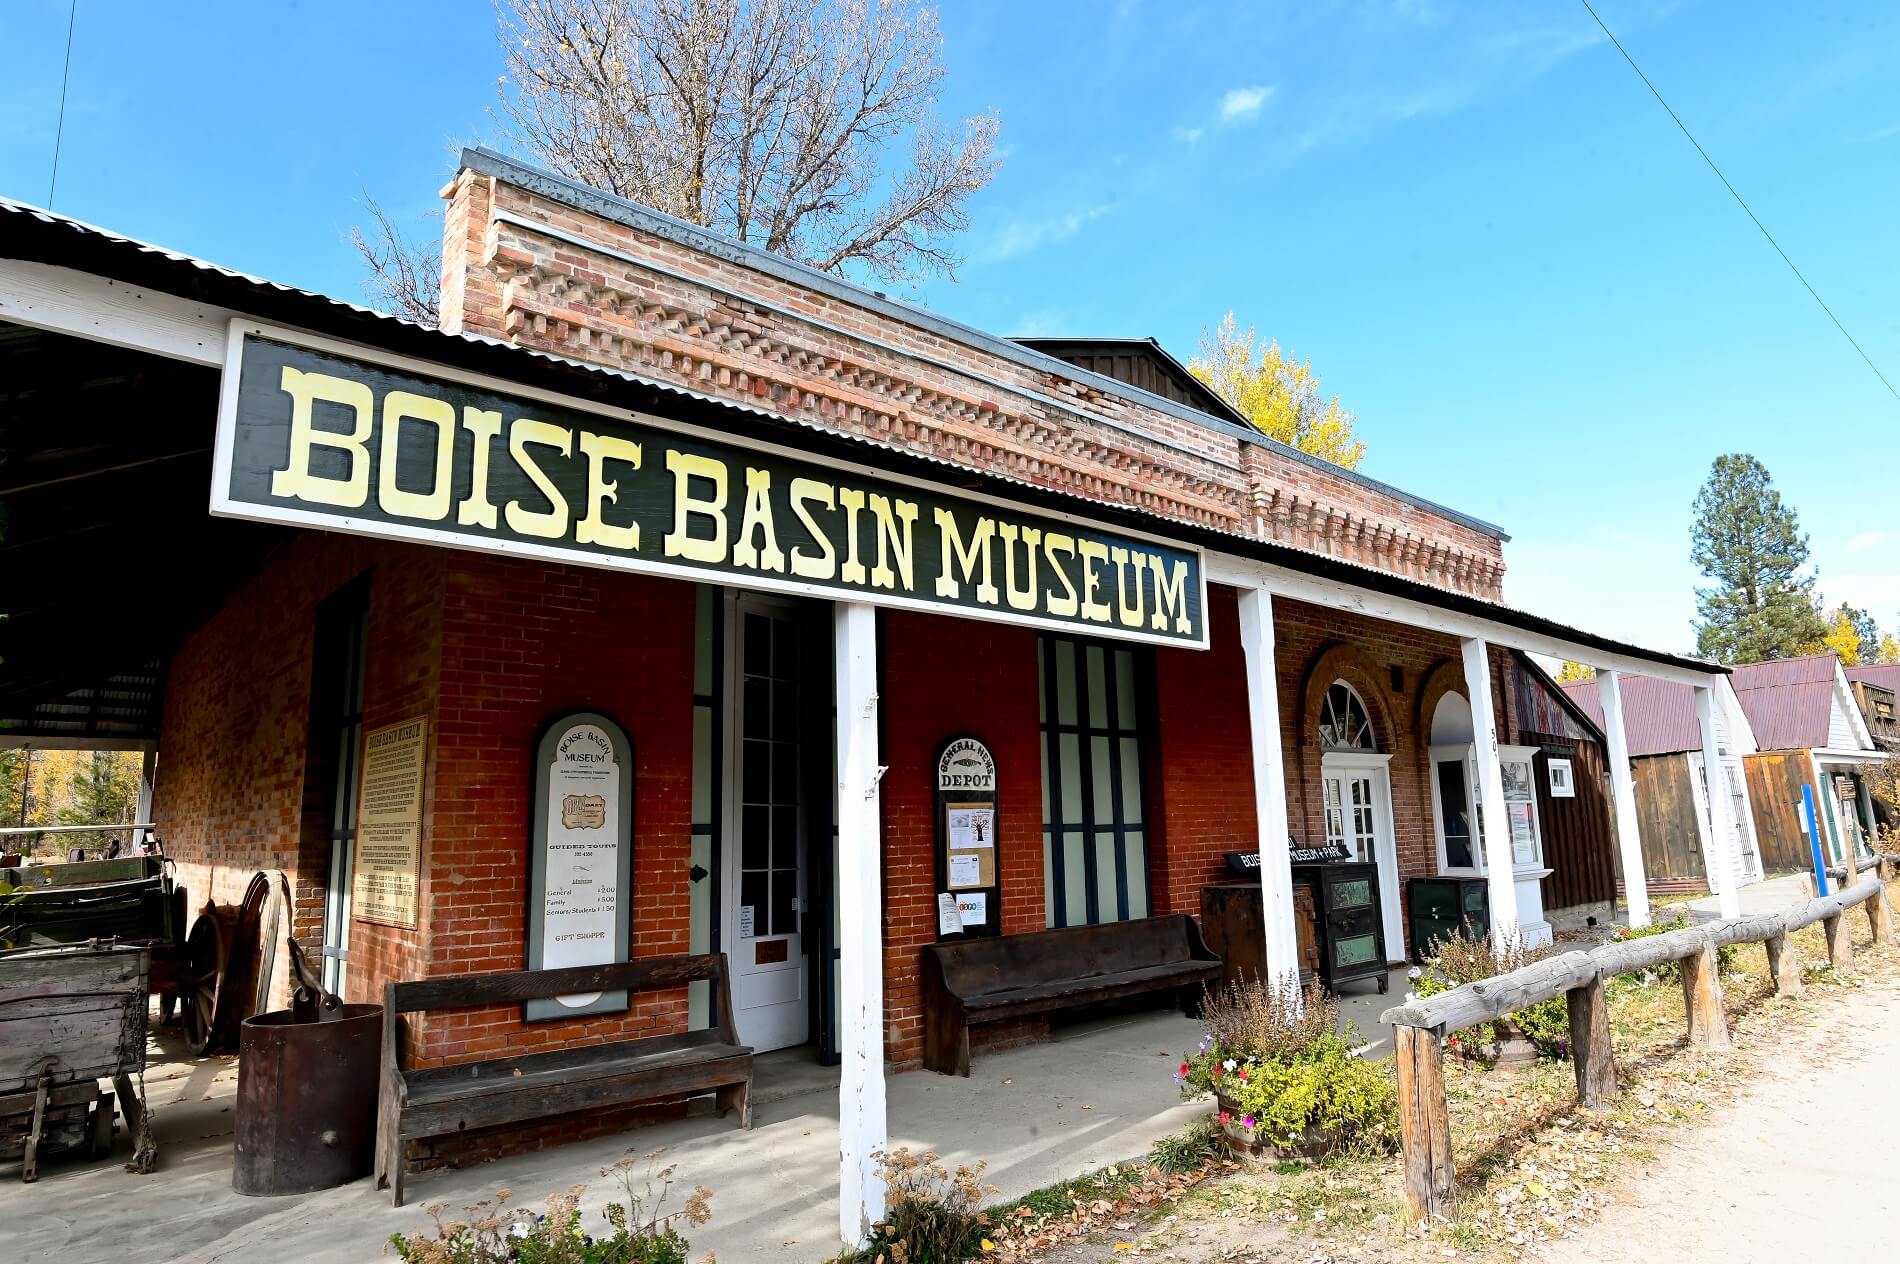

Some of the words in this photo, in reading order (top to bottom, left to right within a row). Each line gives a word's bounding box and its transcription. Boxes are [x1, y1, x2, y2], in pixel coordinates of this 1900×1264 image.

[272, 366, 643, 549] BOISE
[664, 449, 919, 591] BASIN
[933, 507, 1193, 635] MUSEUM
[560, 732, 584, 753] BOISE
[587, 732, 610, 755] BASIN
[564, 753, 605, 763] MUSEUM
[940, 741, 975, 773] GENERAL
[977, 746, 994, 775] NEWS
[941, 774, 991, 787] DEPOT
[1290, 848, 1320, 861] MUSEUM
[1322, 846, 1343, 858] PARK
[555, 933, 575, 942] GIFT
[576, 931, 605, 940] SHOPPE
